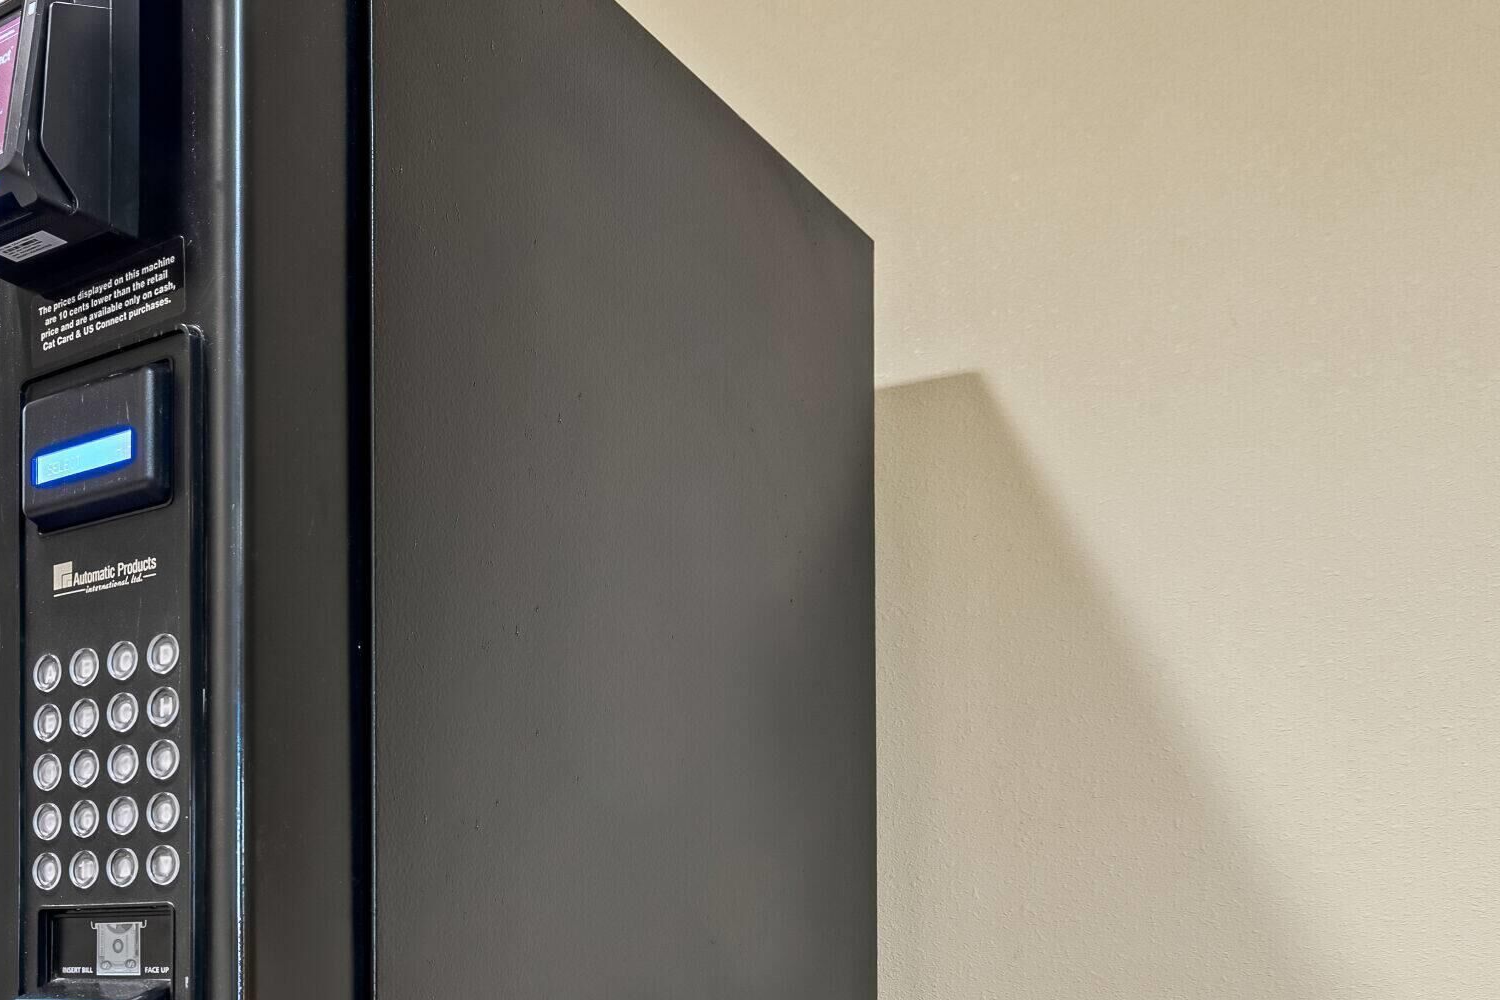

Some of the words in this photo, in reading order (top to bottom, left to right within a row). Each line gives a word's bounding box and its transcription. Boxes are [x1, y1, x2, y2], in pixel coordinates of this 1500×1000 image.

[38, 306, 51, 316] The
[53, 295, 75, 310] prices
[77, 279, 113, 300] displayed
[114, 276, 123, 286] on
[125, 269, 140, 282] this
[141, 255, 175, 275] machine
[40, 326, 59, 341] price
[61, 320, 74, 332] and
[76, 315, 87, 326] are
[89, 301, 123, 322] available
[124, 295, 140, 309] only
[142, 290, 152, 300] on
[154, 281, 176, 297] cash,
[45, 316, 57, 326] are
[59, 310, 67, 320] 10
[69, 302, 89, 316] cents
[91, 294, 112, 308] lower
[113, 286, 131, 299] than
[132, 280, 145, 293] the
[147, 269, 168, 286] retail
[42, 338, 55, 351] Cat
[56, 332, 74, 346] Card
[75, 329, 82, 339] &
[83, 324, 94, 336] US
[95, 311, 127, 331] Connect
[128, 296, 172, 320] purchases.
[73, 565, 115, 586] Automatic
[117, 556, 157, 577] Products
